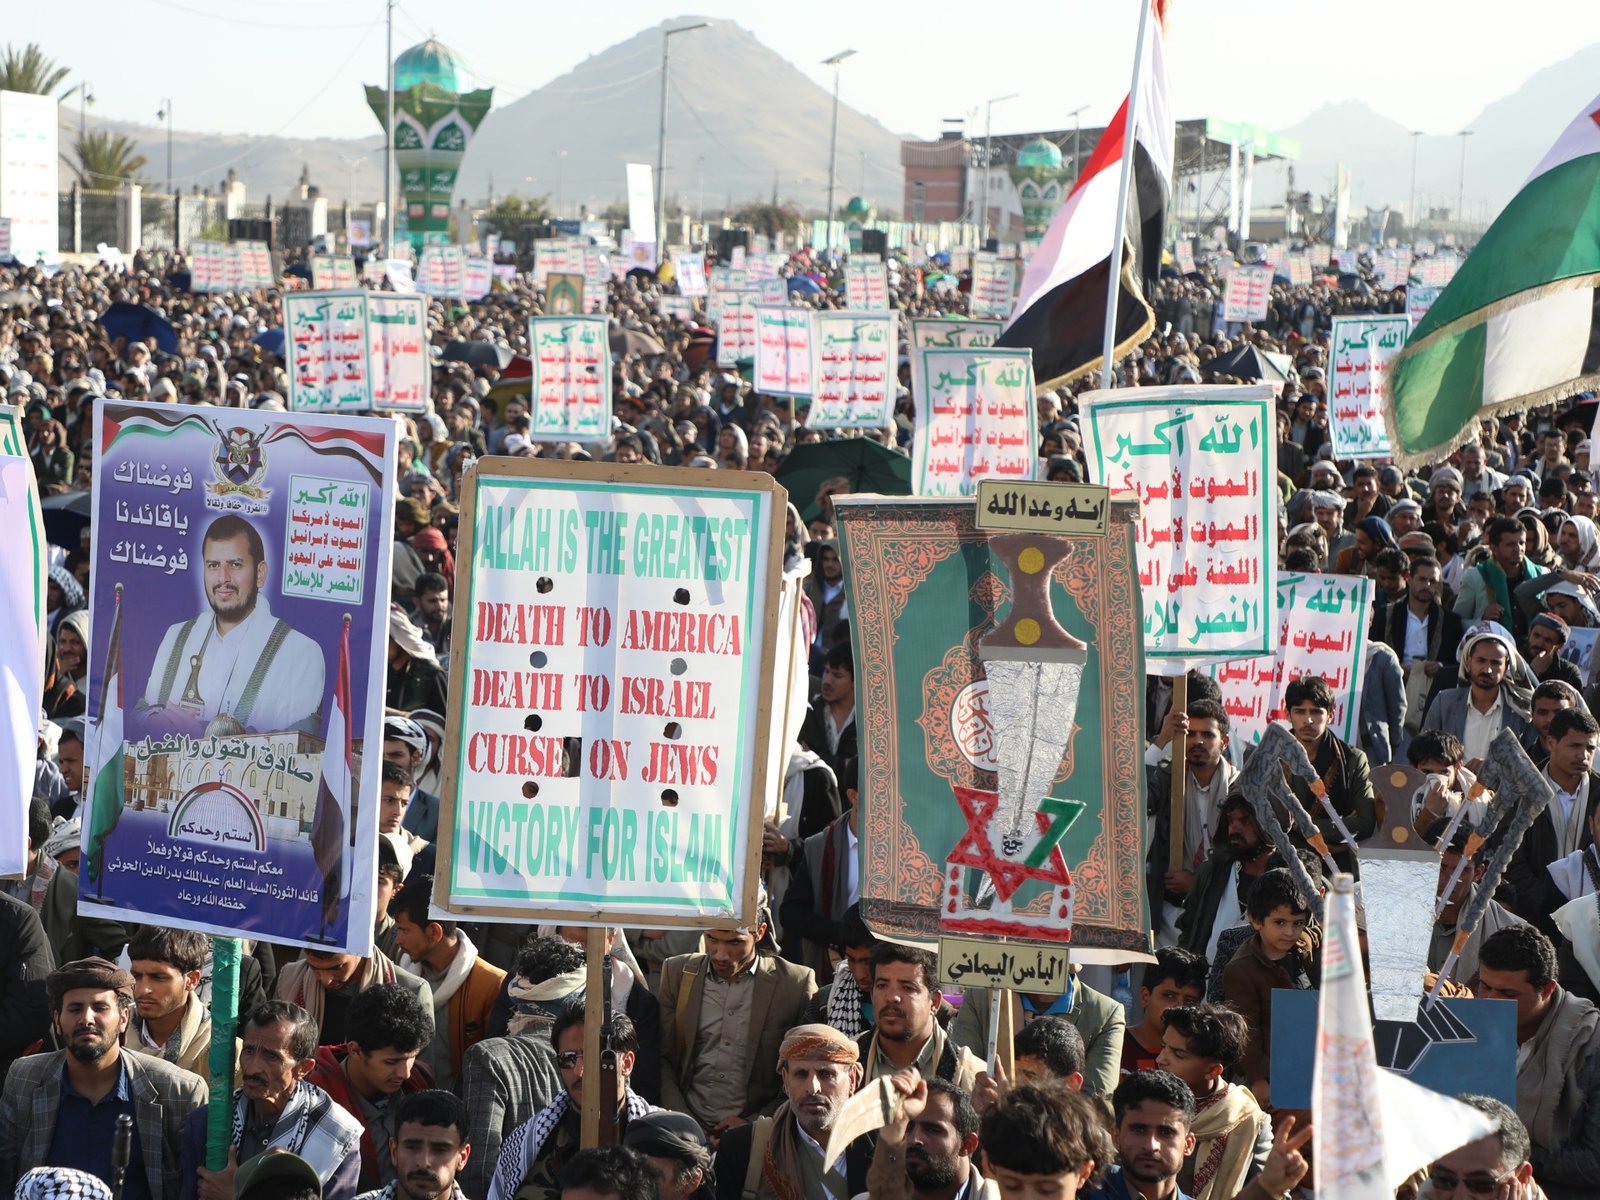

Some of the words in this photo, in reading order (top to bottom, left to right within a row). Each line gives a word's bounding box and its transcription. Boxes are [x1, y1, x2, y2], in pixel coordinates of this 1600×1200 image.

[1105, 408, 1194, 469] أكبر
[1198, 413, 1259, 454] الله
[113, 460, 193, 495] فوضناك
[1189, 470, 1258, 504] الموت
[293, 482, 338, 506] أكبر
[339, 487, 366, 508] الله
[332, 517, 364, 530] الموت
[1065, 497, 1105, 529] إنه
[331, 536, 362, 550] الموت
[479, 505, 551, 572] ALLAH
[556, 508, 578, 574] IS
[585, 510, 627, 576] THE
[633, 511, 749, 582] GREATEST
[1190, 514, 1258, 549] الموت
[109, 540, 189, 575] فوضناك
[288, 552, 316, 566] اليهود
[318, 554, 333, 569] على
[336, 555, 361, 571] اللعنة
[1206, 557, 1258, 584] اللعنة
[326, 575, 360, 594] النصر
[1167, 560, 1198, 593] على
[1305, 578, 1358, 614] الله
[475, 601, 566, 647] DEATH
[576, 606, 611, 648] TO
[620, 609, 742, 656] AMERICA
[1187, 595, 1258, 644] النصر
[1293, 629, 1353, 654] الموت
[471, 668, 564, 711] DEATH
[574, 674, 610, 713] TO
[620, 676, 716, 720] ISRAEL
[136, 733, 199, 761] والفعل
[201, 735, 257, 761] القول
[468, 731, 564, 778] CURSE
[589, 737, 630, 781] ON
[641, 741, 720, 786] JEWS
[256, 745, 314, 783] صادق
[179, 822, 220, 841] وحدكم
[222, 829, 253, 843] لستم
[468, 800, 581, 878] VICTORY
[586, 807, 638, 882] FOR
[645, 810, 723, 884] ISLAM
[108, 856, 142, 873] الحوثي
[194, 850, 231, 869] وحدكم
[231, 857, 257, 871] لستم
[257, 861, 283, 876] معكم
[178, 889, 201, 906] ورعاه
[247, 882, 272, 895] السيد
[272, 884, 298, 900] الثورة
[298, 888, 319, 903] قائد
[217, 897, 247, 910] حفظه
[948, 952, 1015, 982] اليماني
[1012, 950, 1063, 985] البأس
